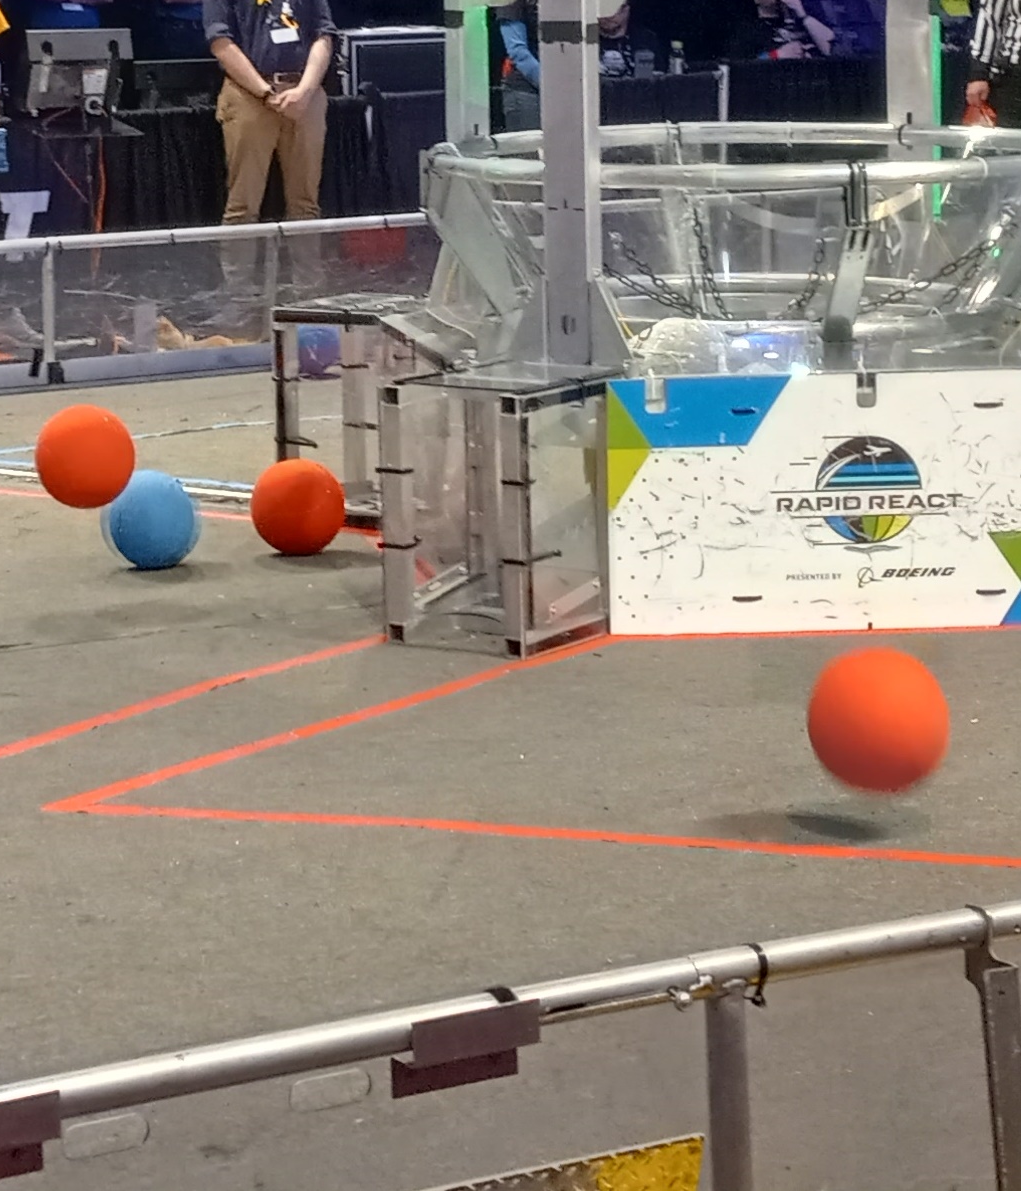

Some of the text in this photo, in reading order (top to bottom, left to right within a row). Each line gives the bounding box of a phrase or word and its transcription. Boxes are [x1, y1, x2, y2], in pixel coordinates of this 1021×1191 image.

[776, 492, 964, 512] RAPID REACT
[785, 572, 842, 581] PRESENTED BY
[881, 566, 956, 579] BOEING
